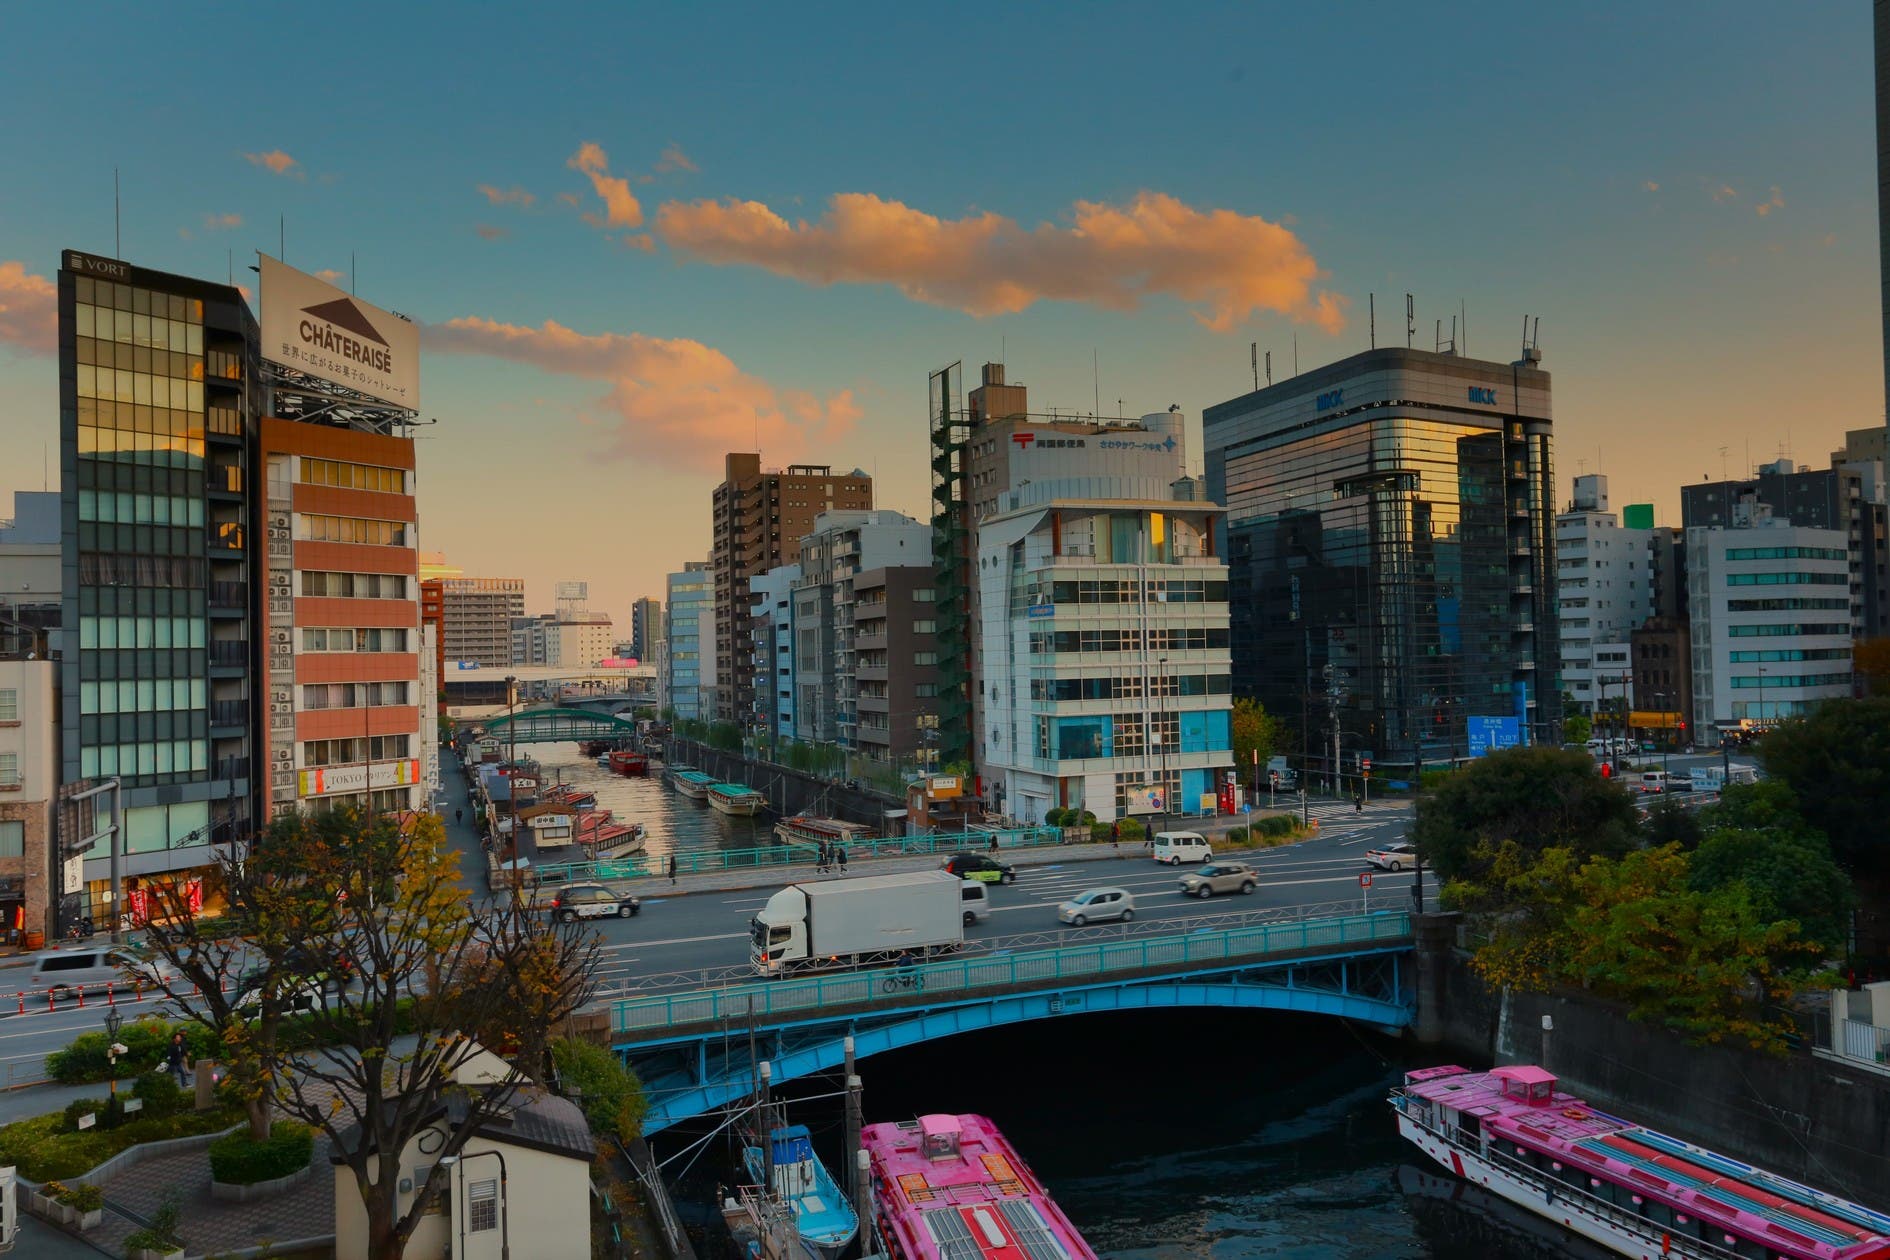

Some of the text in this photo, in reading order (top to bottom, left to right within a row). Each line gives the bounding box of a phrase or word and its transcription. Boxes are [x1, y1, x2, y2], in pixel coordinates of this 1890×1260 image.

[86, 258, 126, 277] VORT
[299, 320, 392, 374] CHÂTERAISÉ
[330, 775, 362, 786] TOKYO
